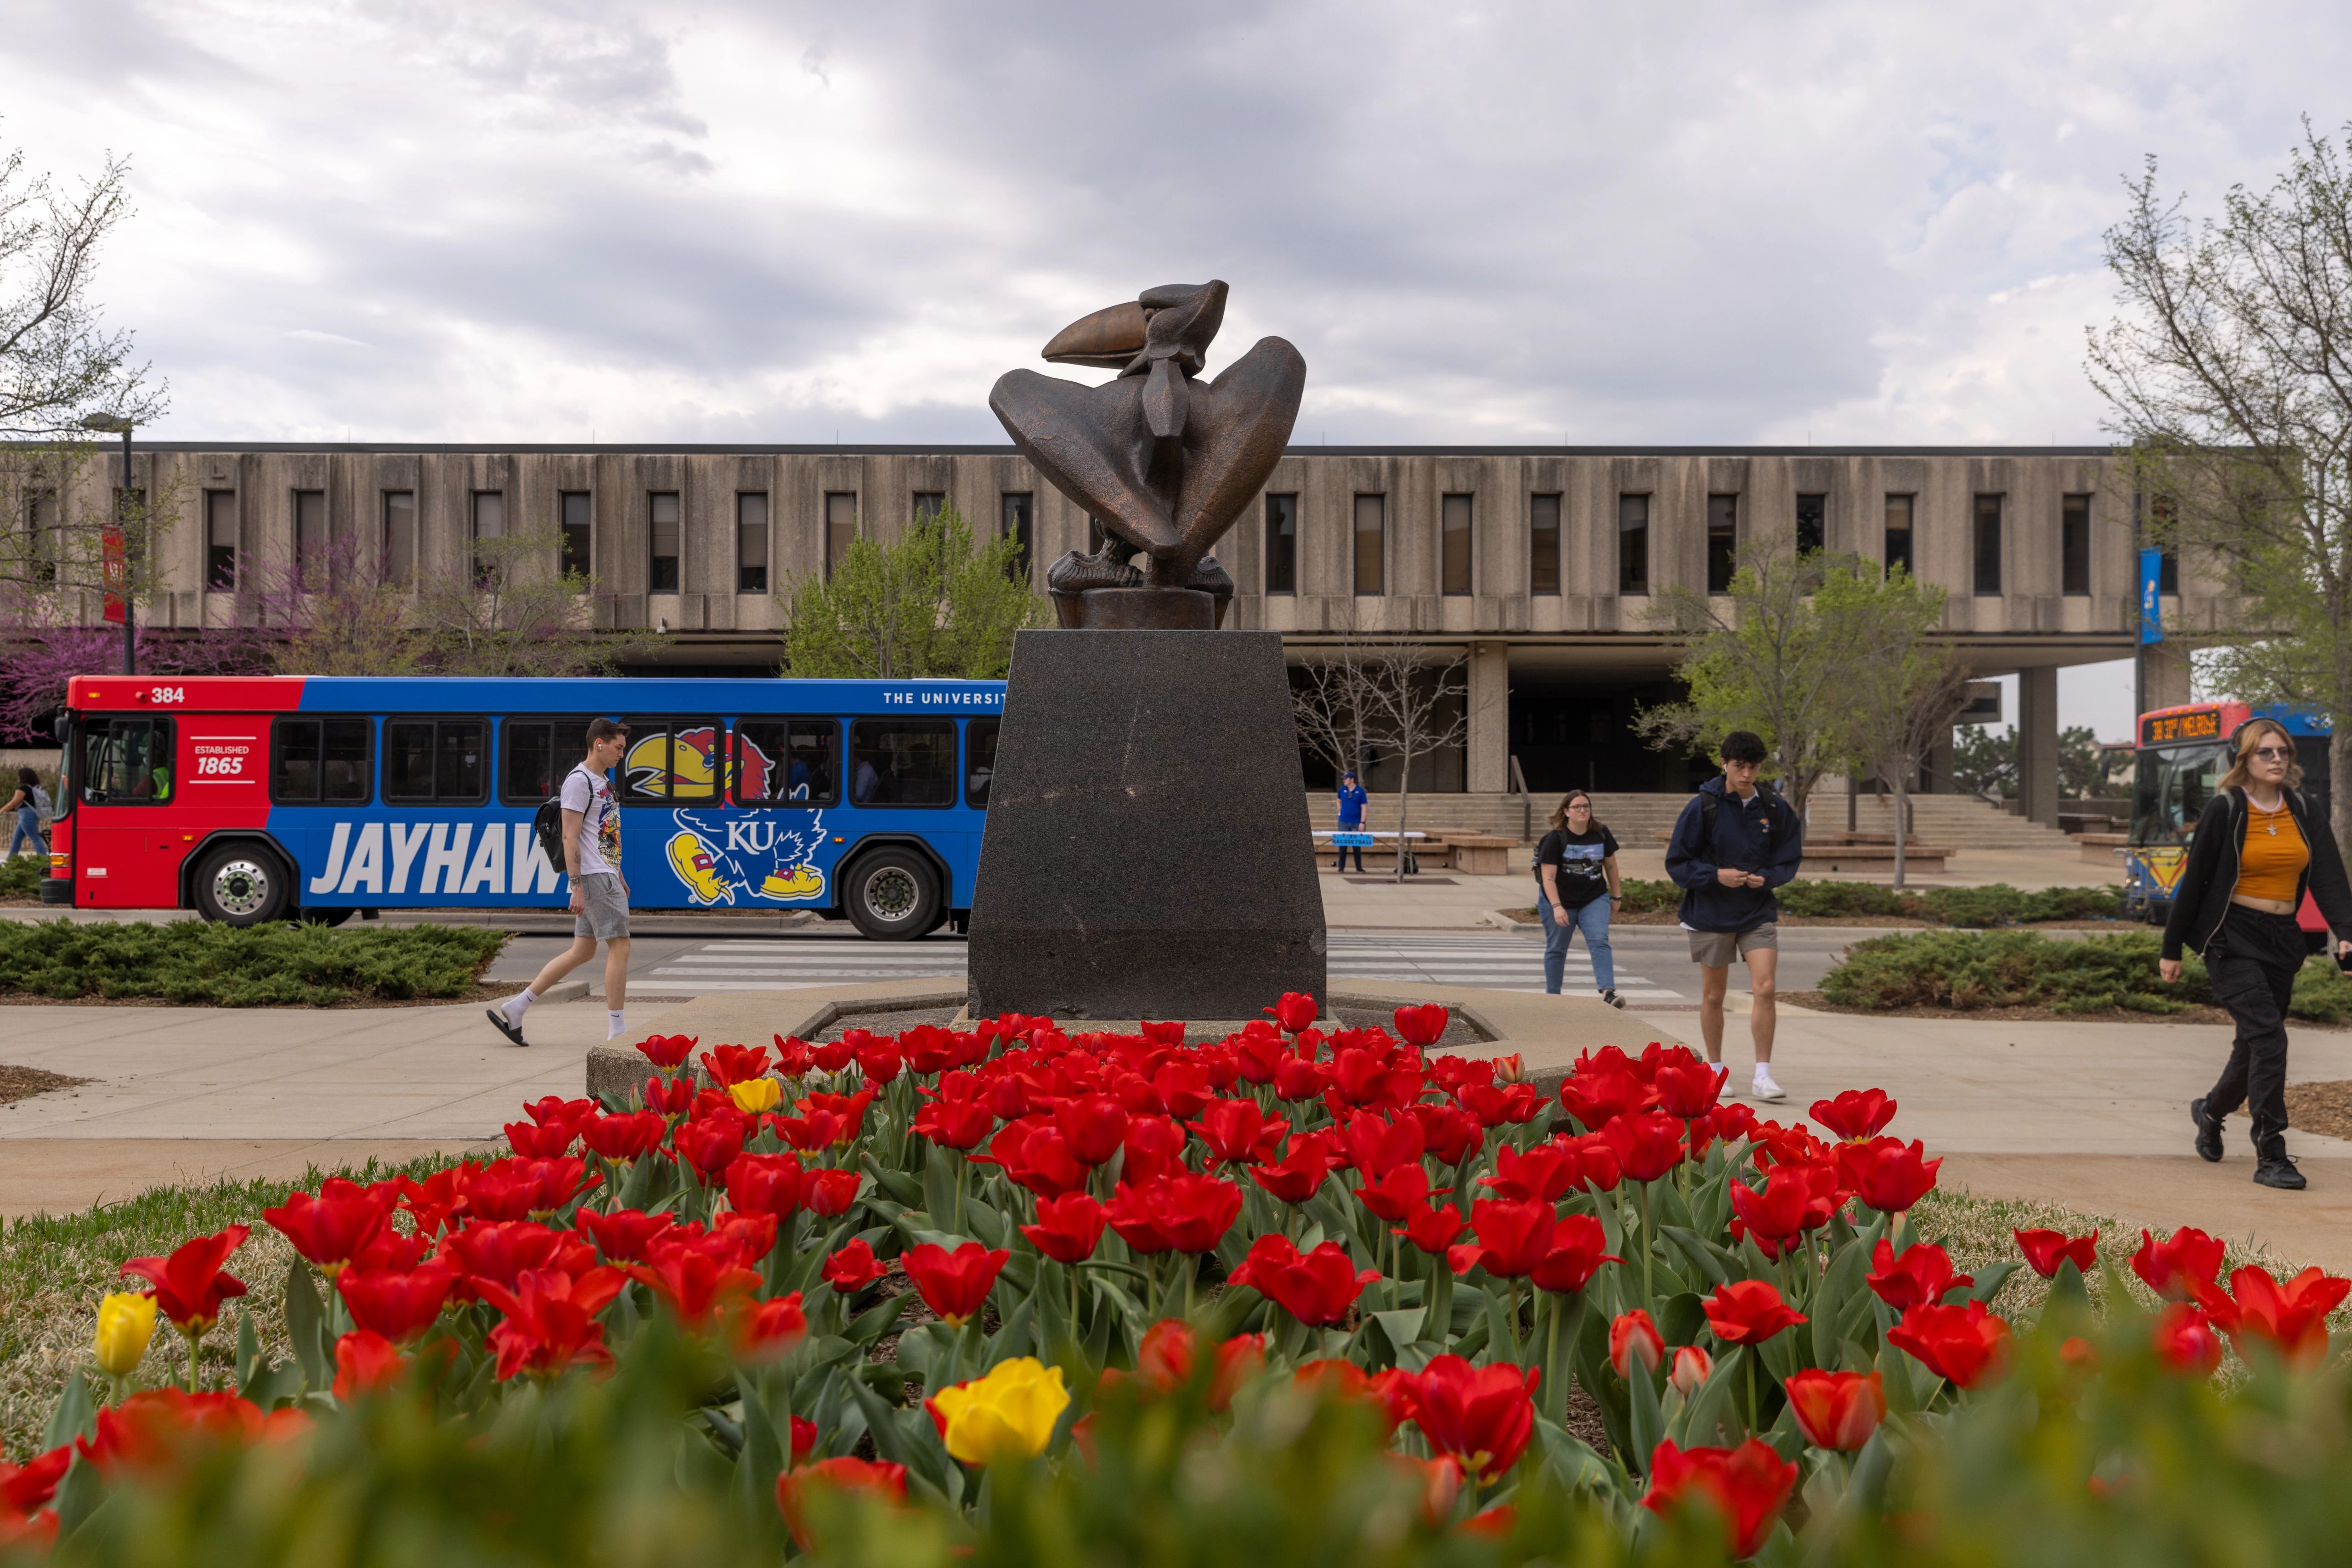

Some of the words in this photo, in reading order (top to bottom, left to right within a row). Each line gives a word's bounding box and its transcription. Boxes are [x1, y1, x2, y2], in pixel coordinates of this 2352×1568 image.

[152, 687, 185, 703] 384
[884, 693, 913, 704] THE
[195, 746, 249, 755] ESTABLISHED
[198, 757, 243, 774] 1865
[725, 821, 776, 855] KU
[309, 823, 573, 894] JAYHAW
